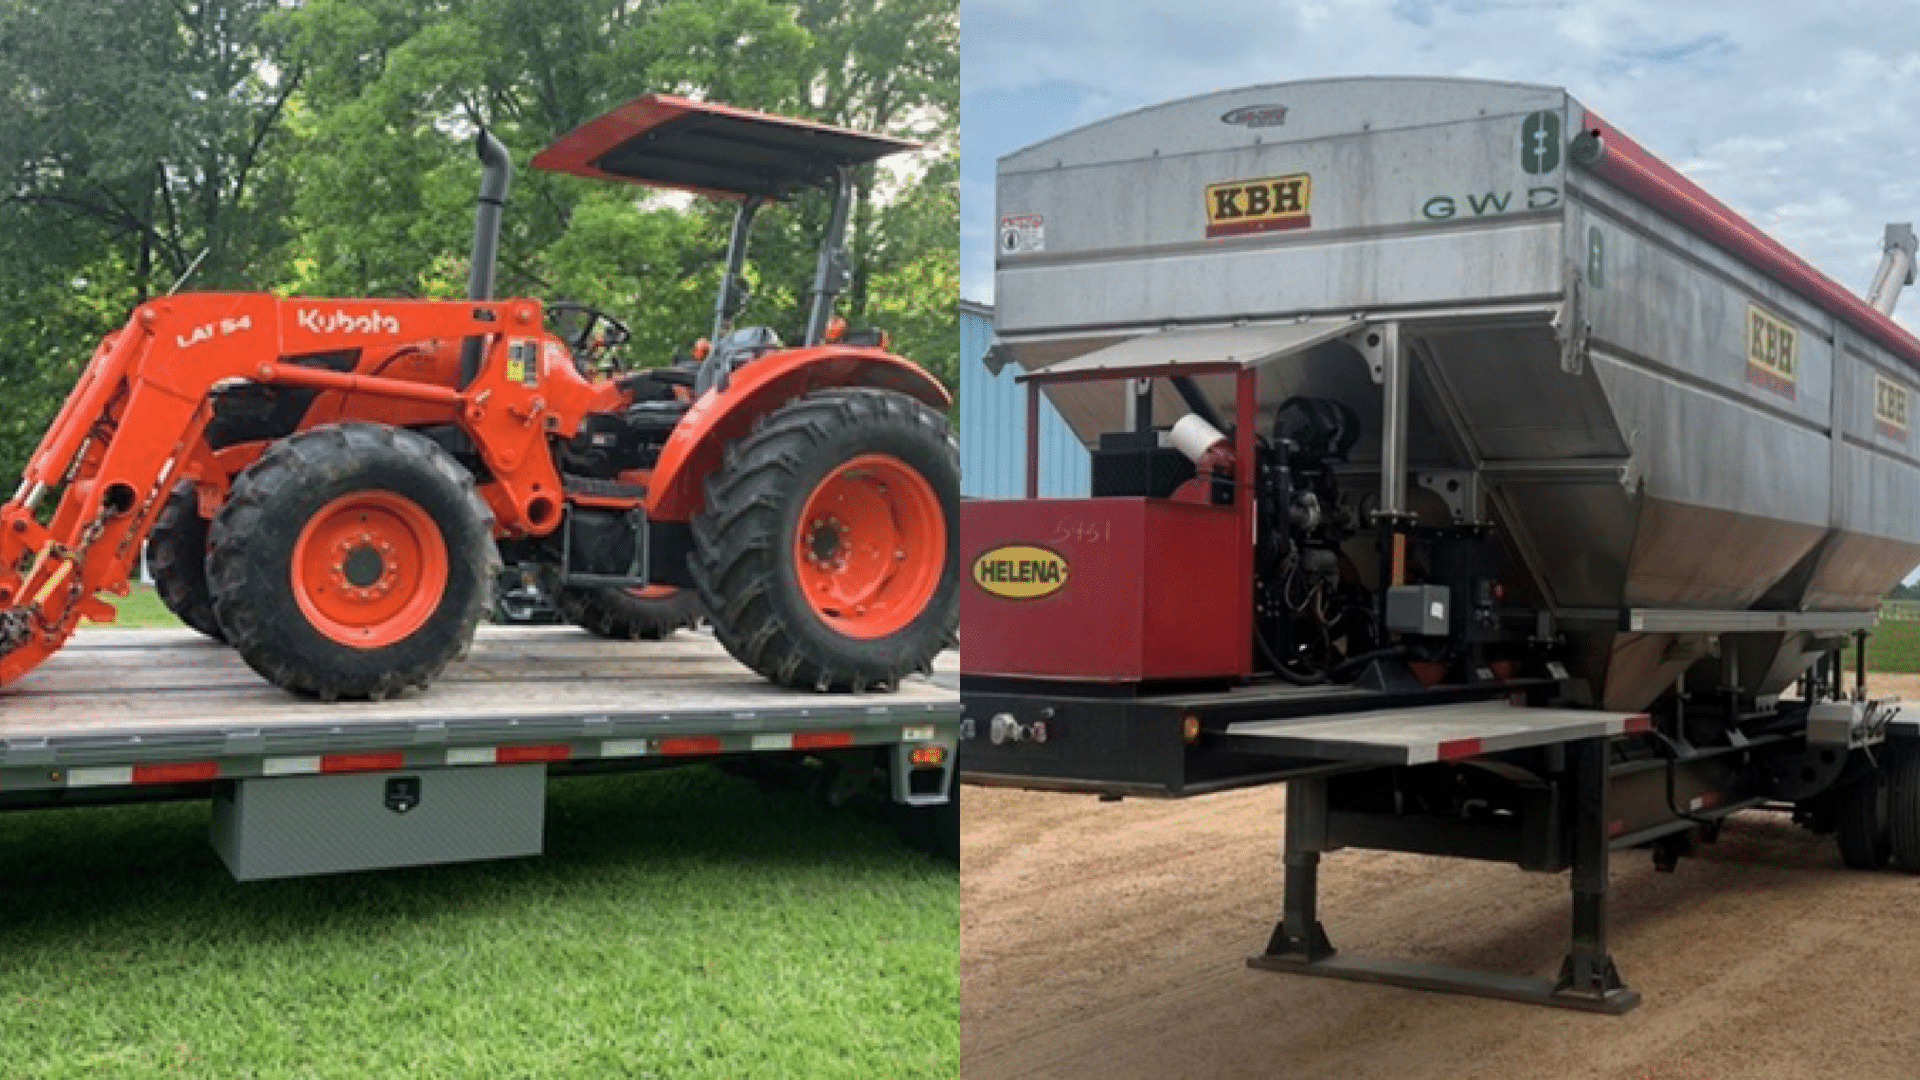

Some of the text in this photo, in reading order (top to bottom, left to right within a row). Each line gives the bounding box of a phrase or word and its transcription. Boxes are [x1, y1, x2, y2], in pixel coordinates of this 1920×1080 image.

[1522, 110, 1560, 175] 8
[1213, 181, 1302, 220] KBH
[297, 308, 400, 334] Kubota
[980, 560, 1060, 584] HELENA
